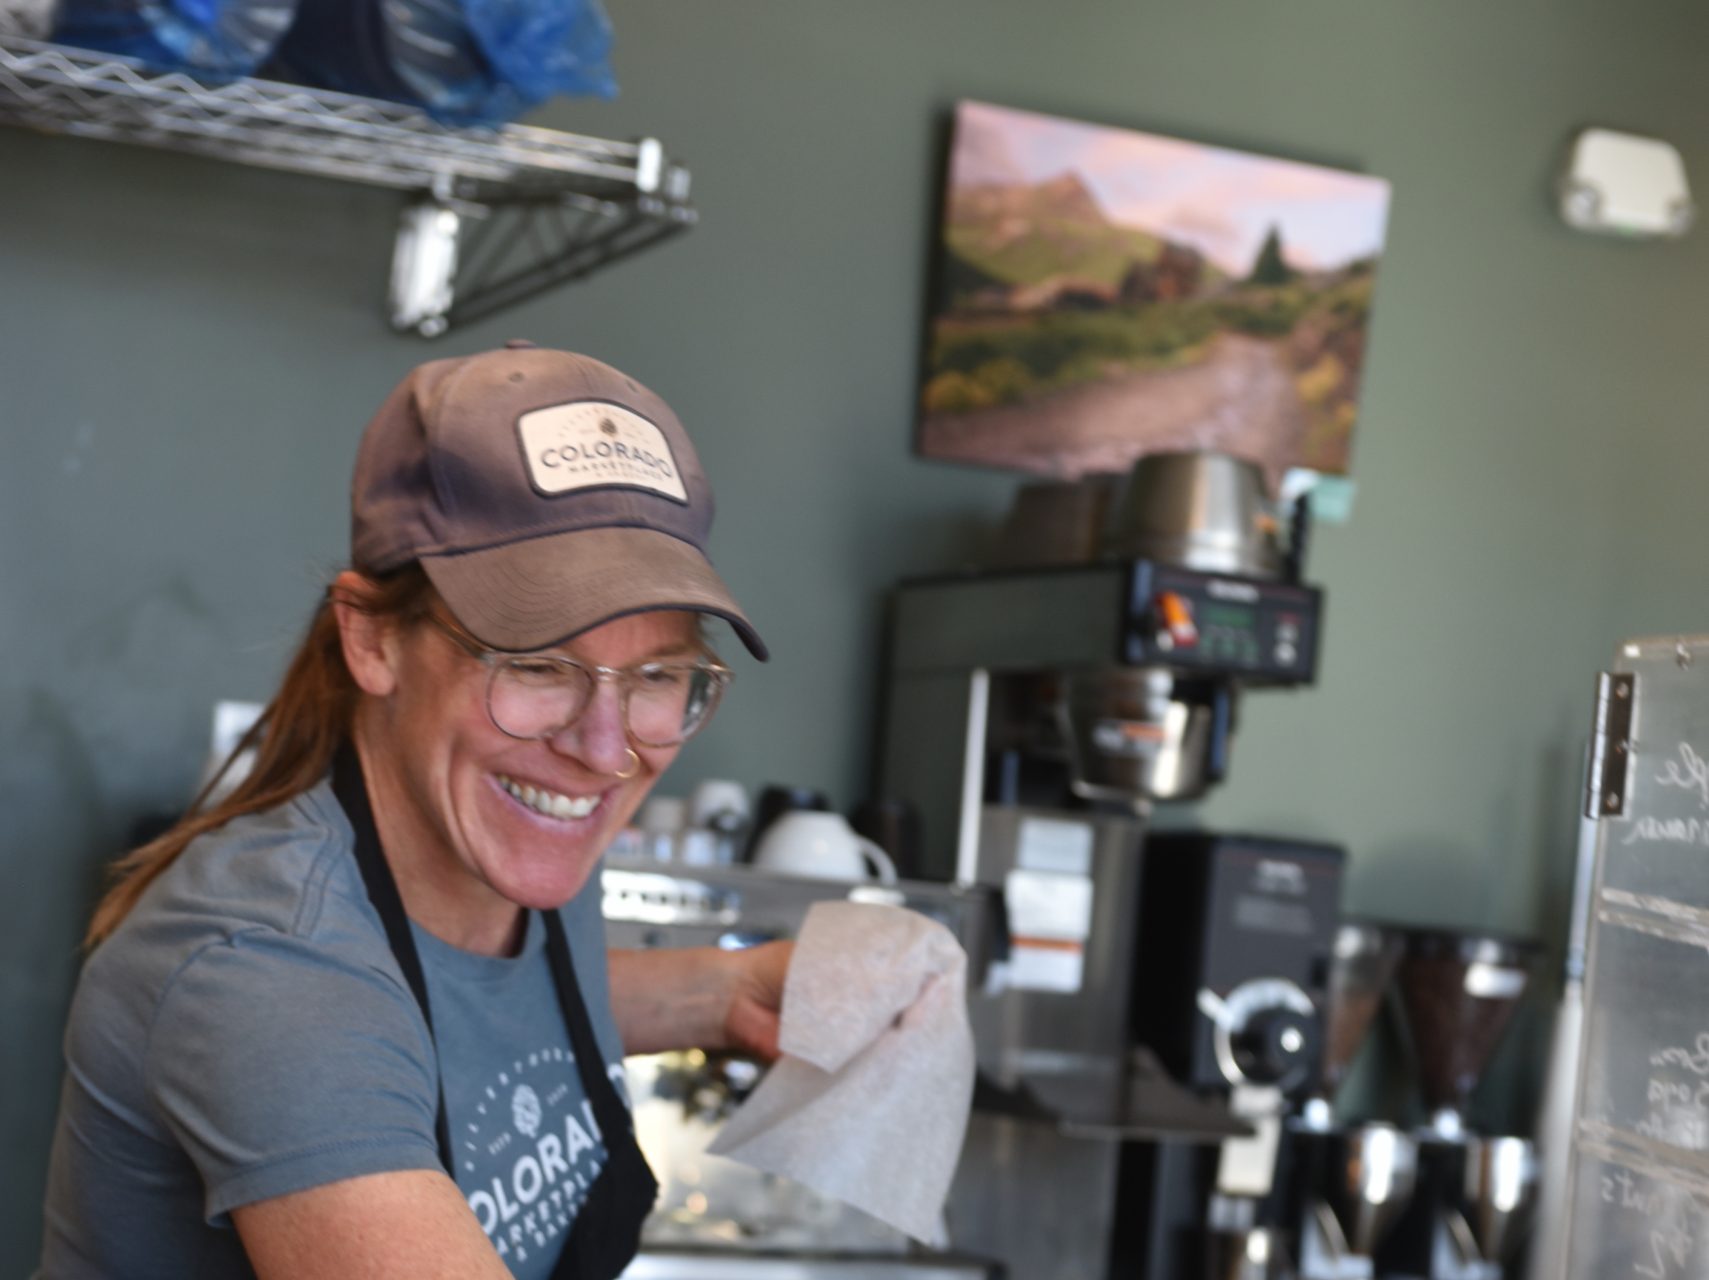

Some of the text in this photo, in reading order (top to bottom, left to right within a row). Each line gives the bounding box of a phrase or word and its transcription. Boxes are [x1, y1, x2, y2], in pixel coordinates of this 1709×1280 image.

[541, 441, 672, 478] COLORADO
[468, 1099, 602, 1236] OLORA
[498, 1148, 608, 1254] ARKETPLA
